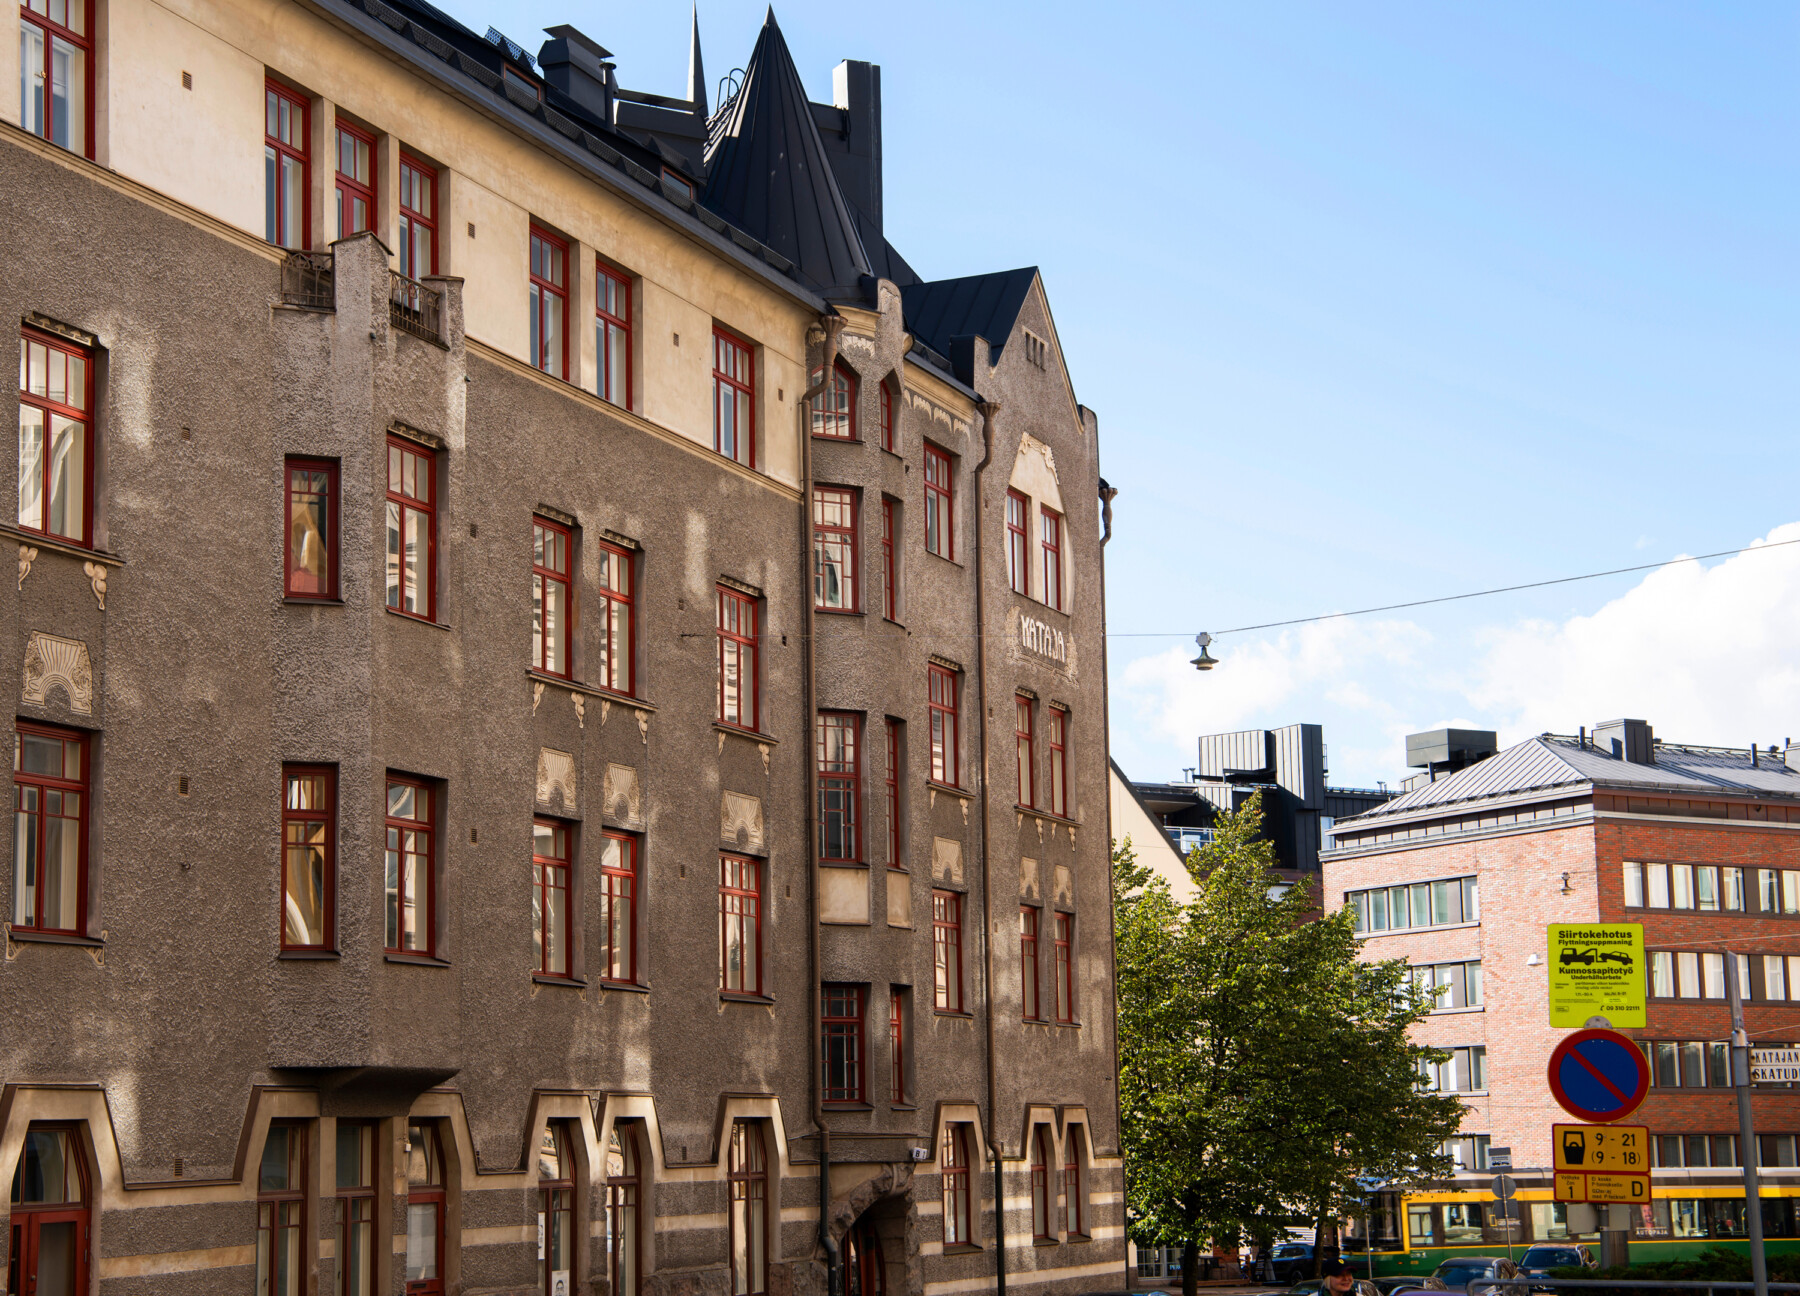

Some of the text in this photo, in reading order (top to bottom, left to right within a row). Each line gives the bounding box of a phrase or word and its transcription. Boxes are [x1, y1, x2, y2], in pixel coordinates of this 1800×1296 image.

[1020, 614, 1065, 662] KATAJA
[1558, 930, 1632, 939] Siirtokehotus
[1559, 967, 1634, 975] Kunnossapitotyö
[1754, 1068, 1800, 1079] SKATUD
[1595, 1133, 1604, 1146] 9
[1622, 1133, 1635, 1147] 21
[1591, 1150, 1604, 1164] (9
[1622, 1151, 1641, 1165] 18)
[1568, 1186, 1573, 1199] 1
[1632, 1181, 1643, 1197] D
